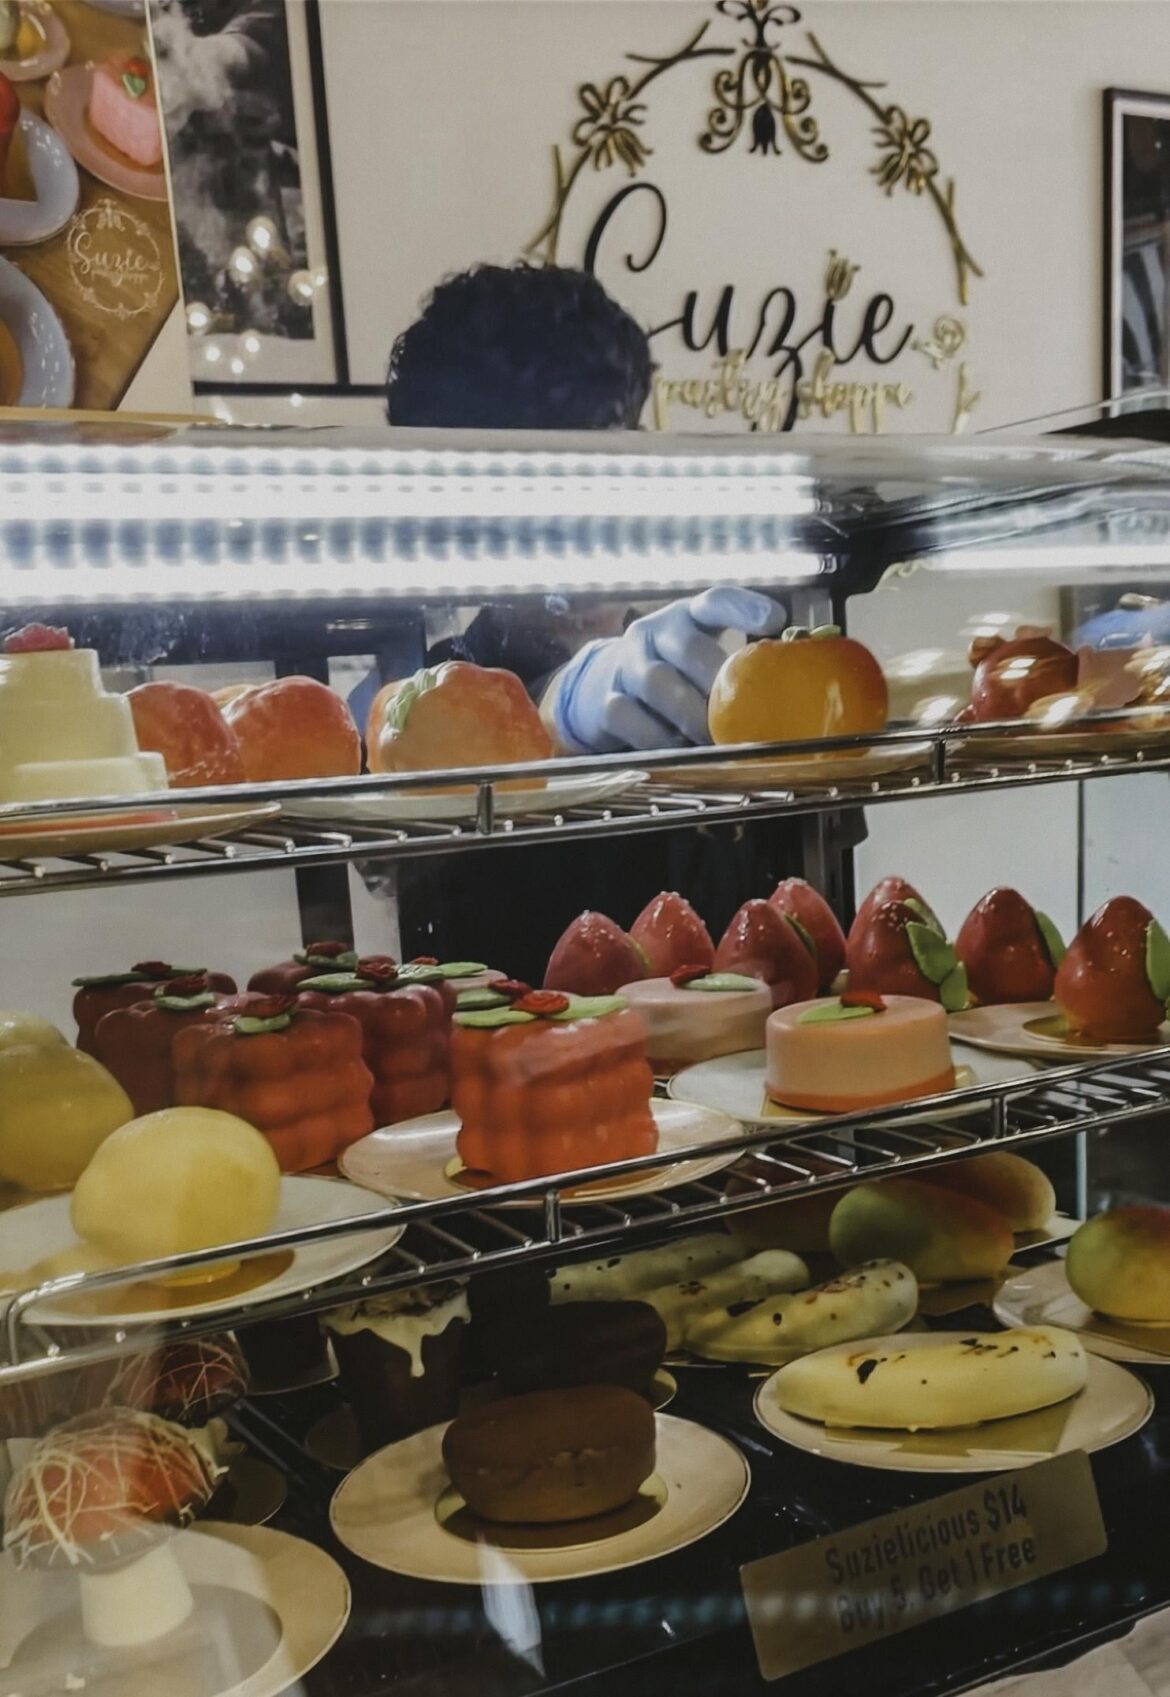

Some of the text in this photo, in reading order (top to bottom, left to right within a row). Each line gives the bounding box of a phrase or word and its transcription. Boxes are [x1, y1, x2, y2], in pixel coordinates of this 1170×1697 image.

[74, 231, 149, 287] Suzie
[825, 1483, 1027, 1584] Suzielicious $14
[838, 1589, 885, 1633] Buy
[918, 1557, 961, 1601] Get
[979, 1537, 1037, 1580] Free
